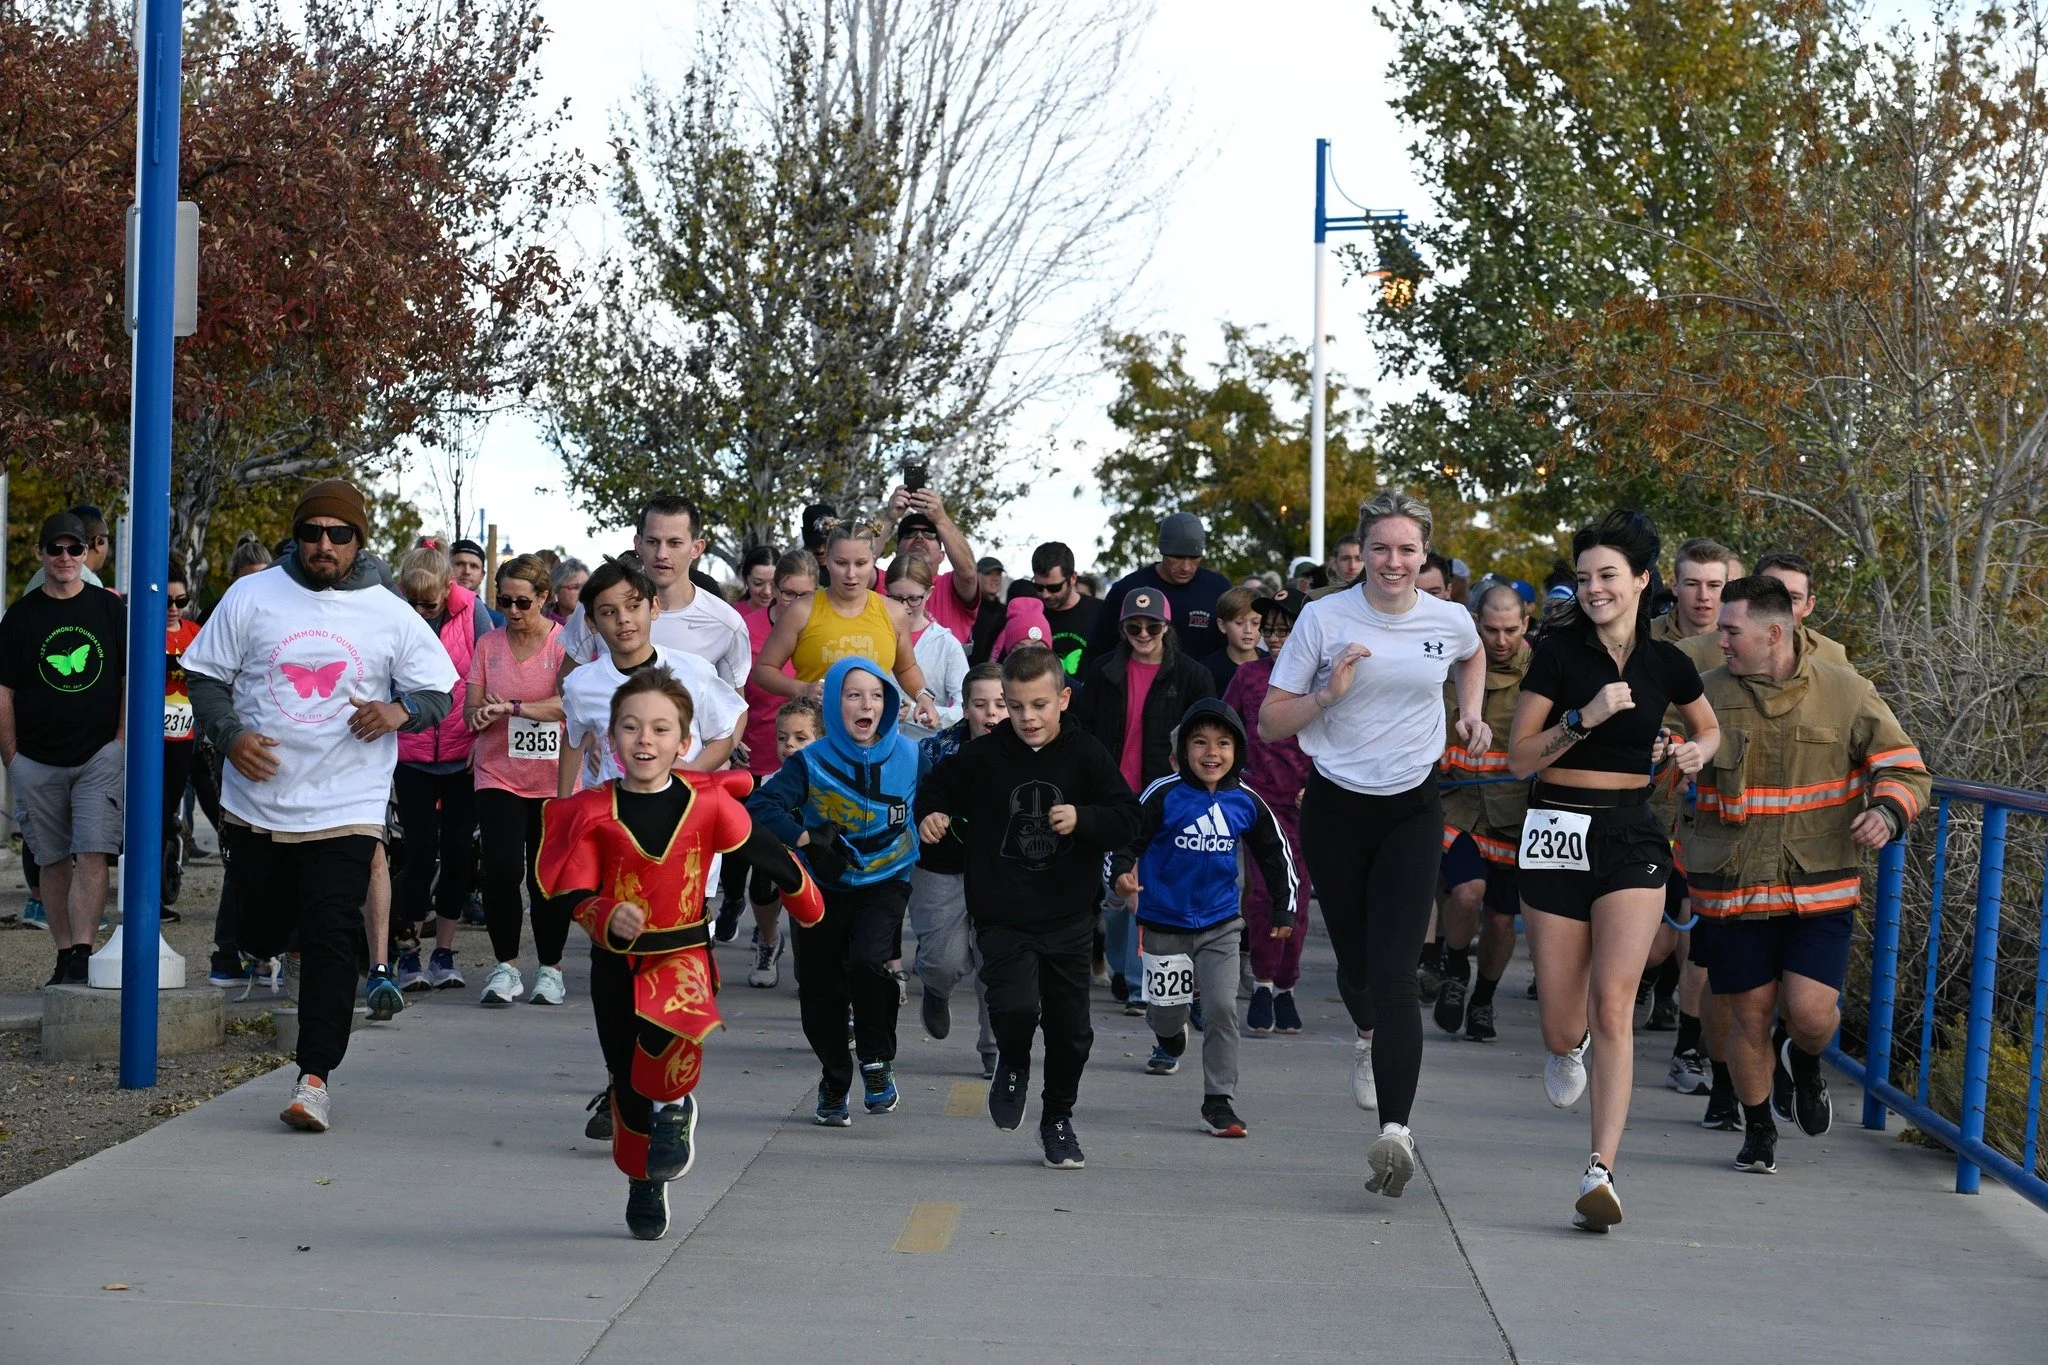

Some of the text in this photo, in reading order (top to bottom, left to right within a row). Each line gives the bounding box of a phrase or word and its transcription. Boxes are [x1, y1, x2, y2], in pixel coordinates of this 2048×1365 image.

[45, 626, 74, 643] HAMMOND
[75, 626, 104, 658] FOUNDATION
[267, 629, 365, 682] LIZZY HAMMOND FOUNDATION
[164, 714, 193, 731] 2314
[514, 731, 557, 752] 2353
[1174, 833, 1235, 852] adidas
[1526, 829, 1583, 861] 2320
[1146, 969, 1194, 997] 2328
